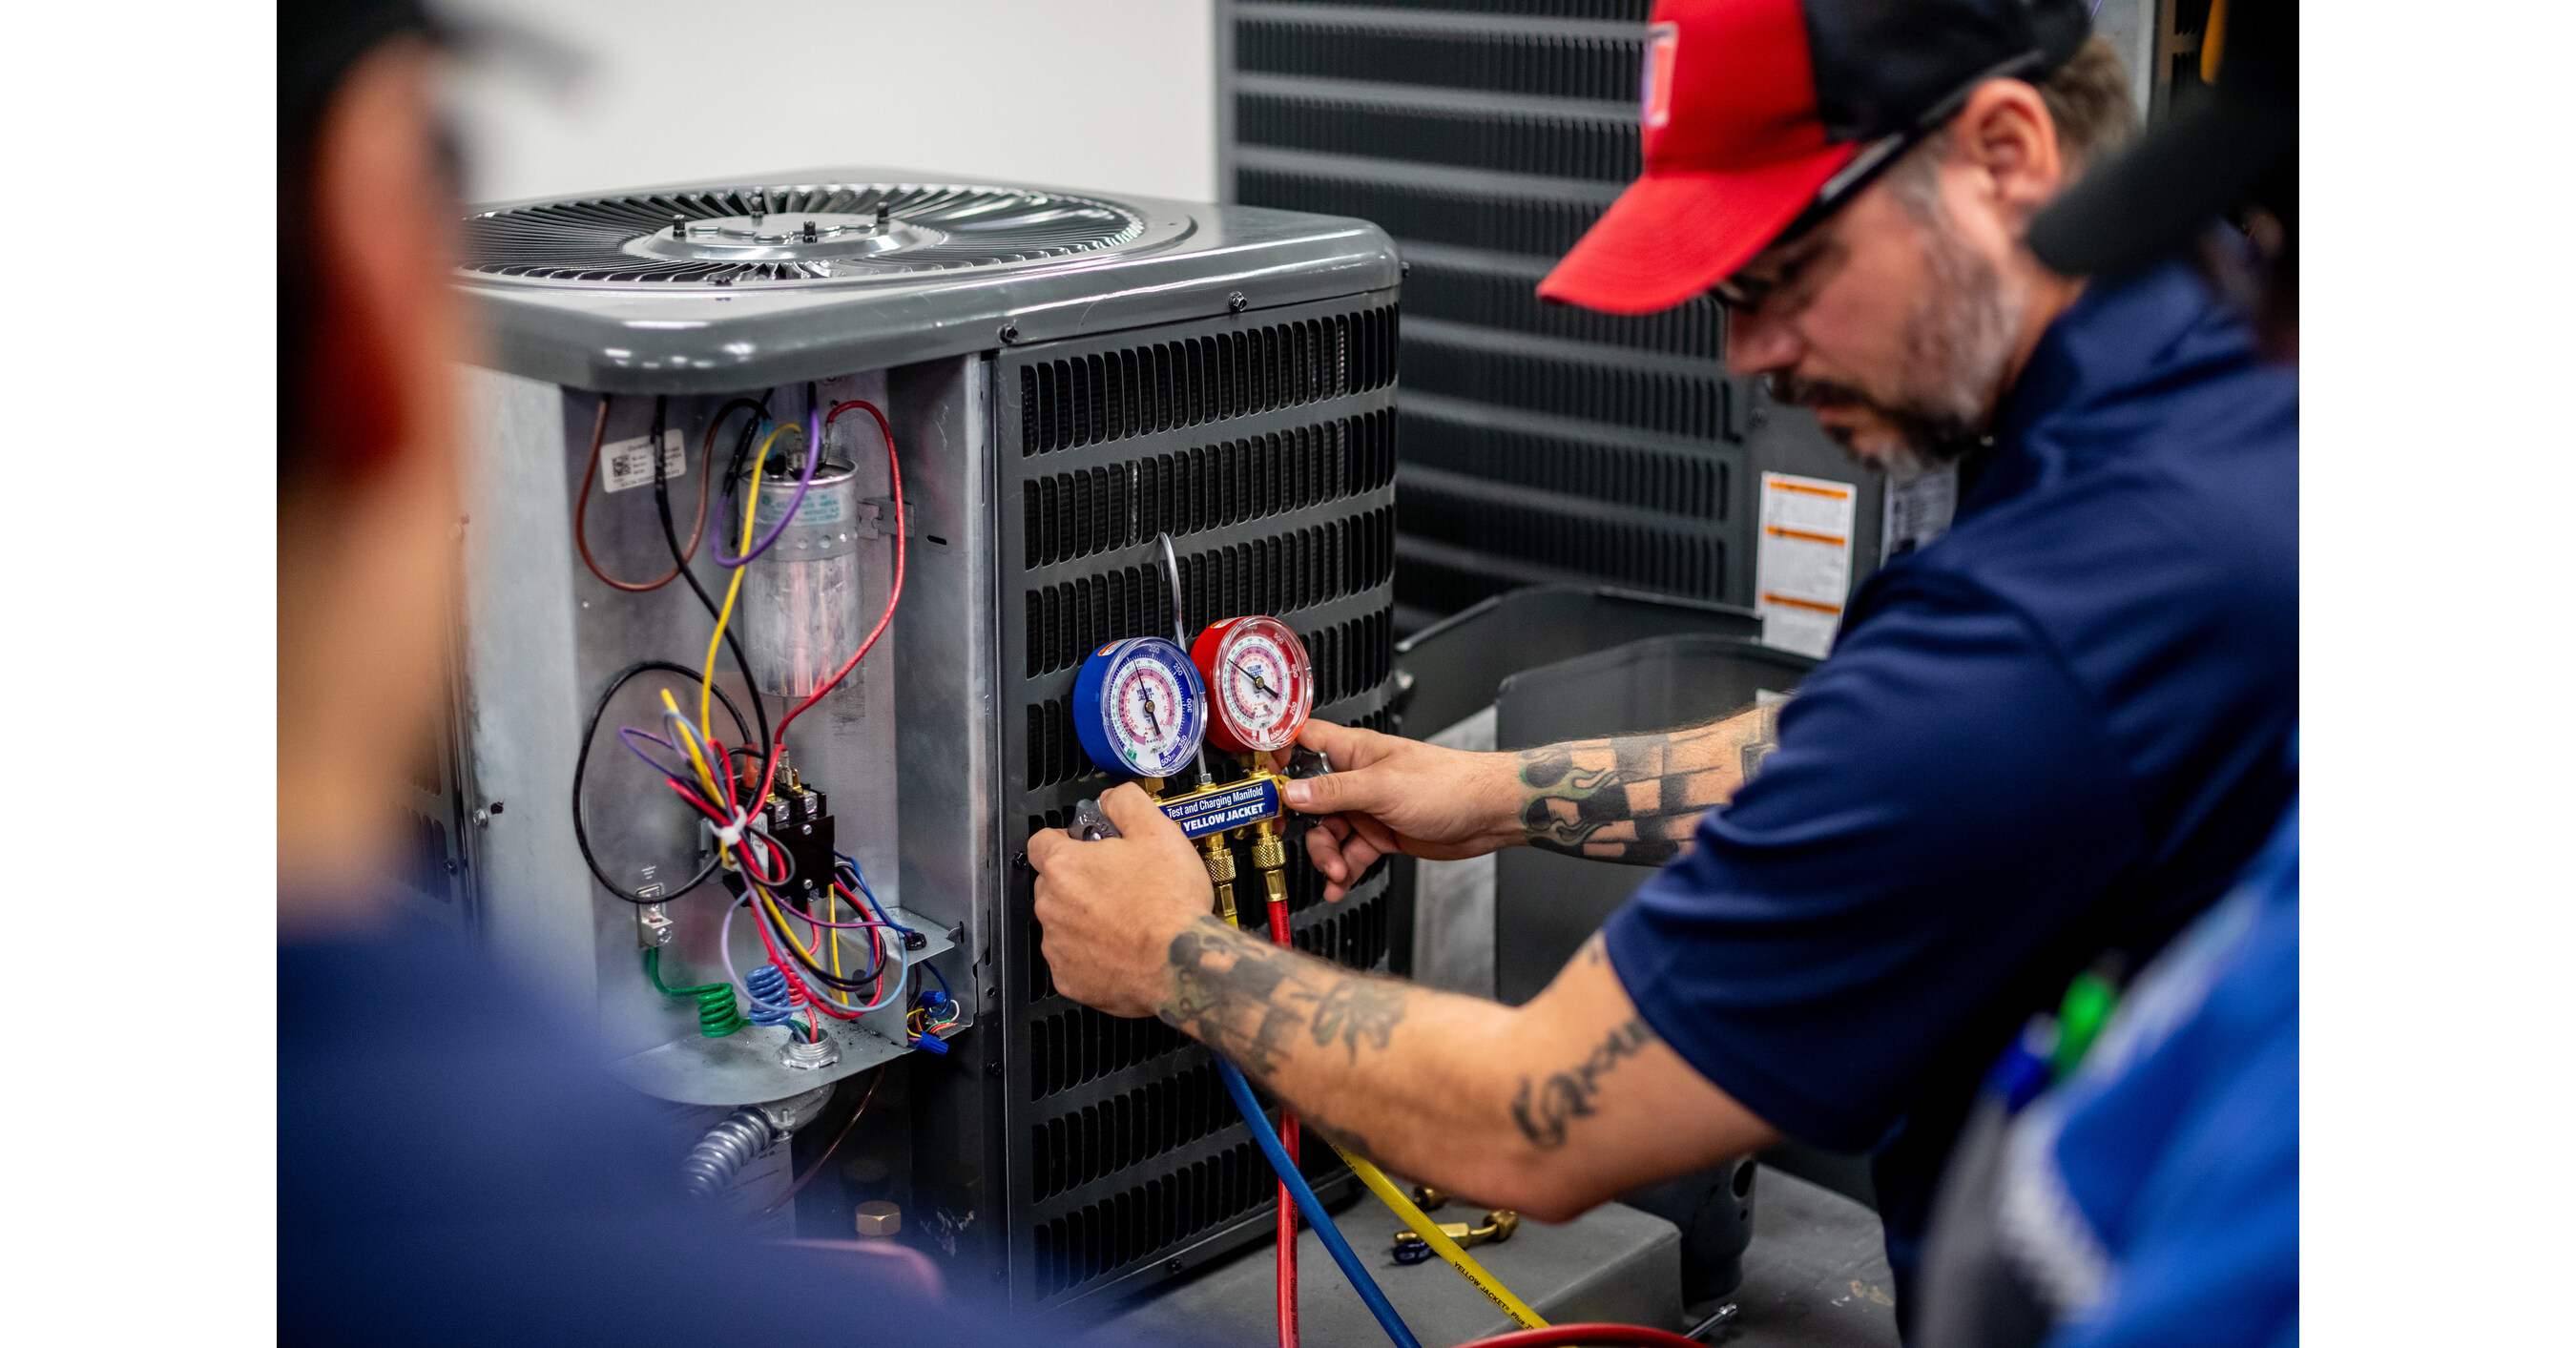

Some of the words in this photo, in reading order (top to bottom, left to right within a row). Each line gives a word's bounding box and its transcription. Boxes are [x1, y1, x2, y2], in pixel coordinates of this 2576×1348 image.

[1149, 644, 1160, 653] 200
[1173, 662, 1183, 676] 250
[1247, 664, 1261, 673] YELLOW
[1289, 701, 1298, 715] 700
[1177, 735, 1188, 749] 350
[1270, 730, 1280, 740] 800
[1160, 755, 1173, 767] 500
[1167, 807, 1183, 819] Test
[1184, 802, 1198, 815] and
[1199, 796, 1233, 812] Charging
[1233, 785, 1264, 802] Manifold
[1183, 812, 1226, 832] YELLOW
[1226, 802, 1265, 821] JACKET
[1453, 1261, 1481, 1286] YELLOW
[1480, 1286, 1508, 1311] JACKET
[1510, 1311, 1526, 1326] Plus
